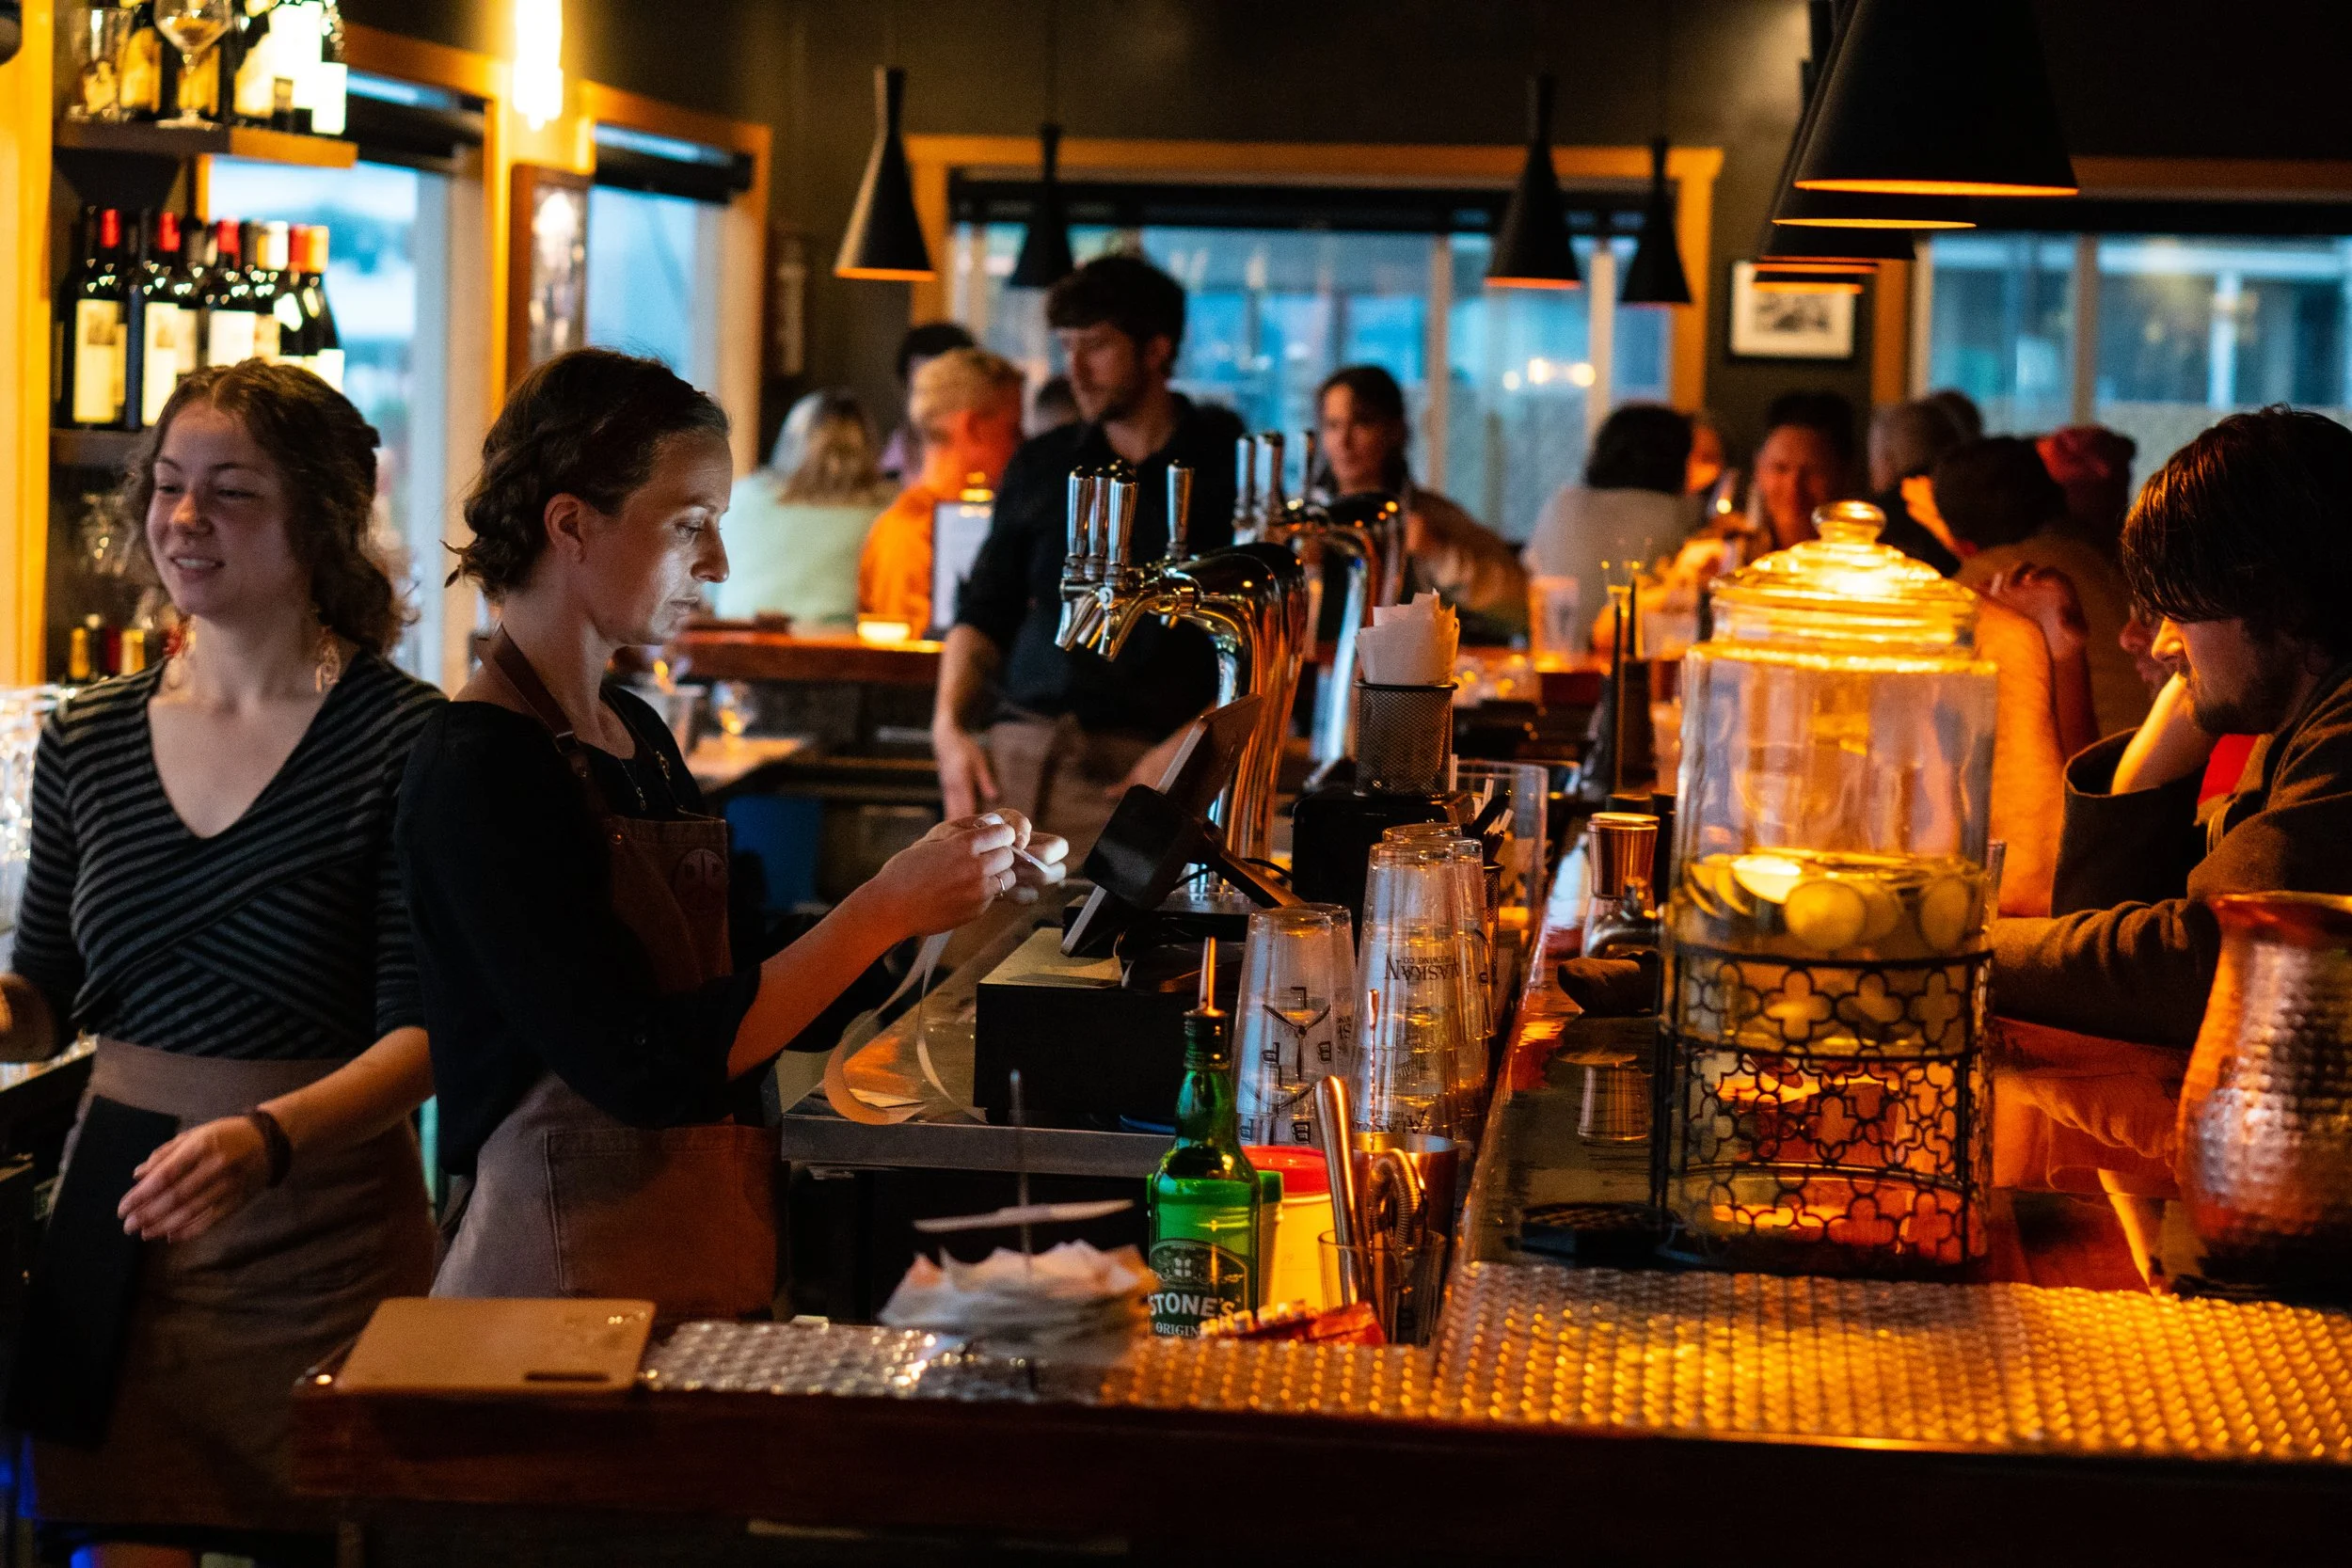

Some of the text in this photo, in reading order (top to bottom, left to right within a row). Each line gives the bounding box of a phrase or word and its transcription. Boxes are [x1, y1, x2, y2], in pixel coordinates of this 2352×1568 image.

[1261, 1040, 1332, 1065] B P
[1291, 1121, 1311, 1145] B
[1148, 1291, 1235, 1318] STONE'S
[1155, 1322, 1200, 1337] ORIGIN
